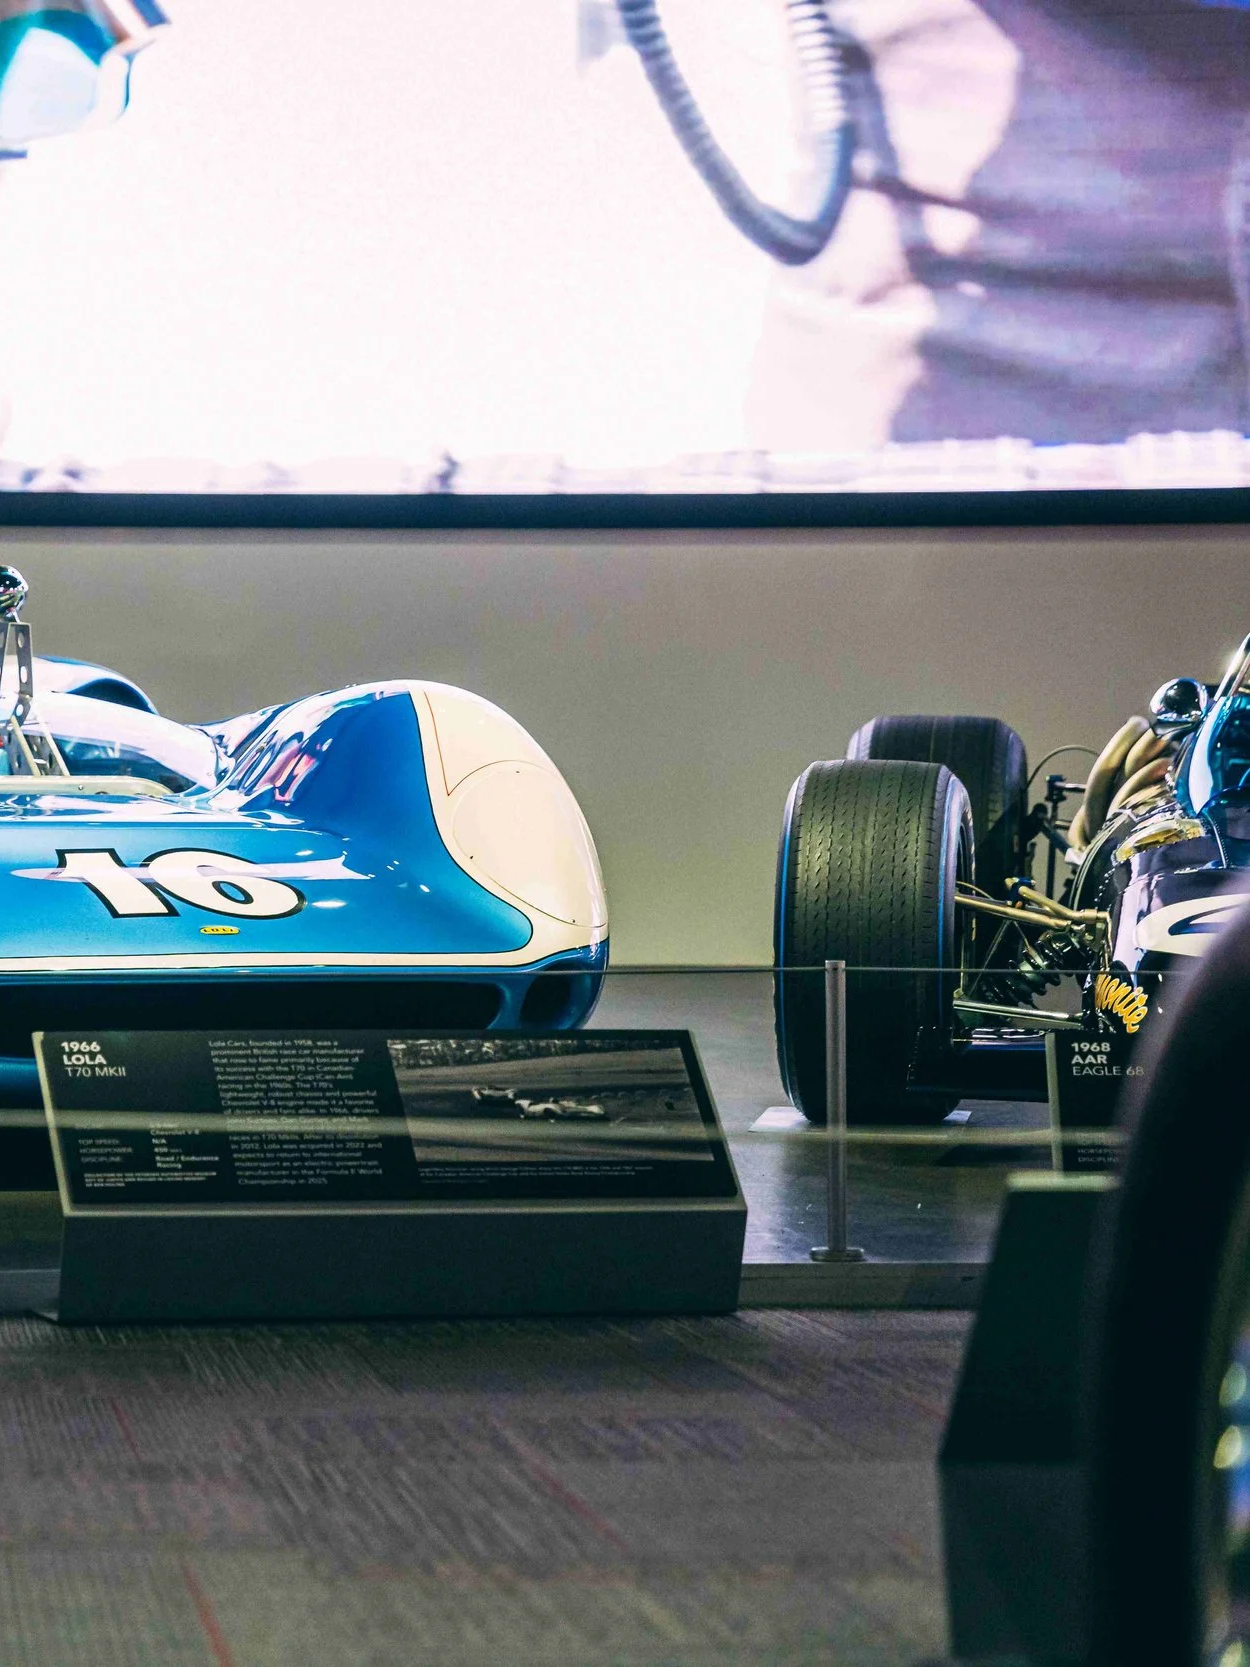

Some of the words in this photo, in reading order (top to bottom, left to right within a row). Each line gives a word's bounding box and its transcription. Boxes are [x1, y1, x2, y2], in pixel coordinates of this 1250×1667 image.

[55, 847, 307, 920] 16
[61, 1041, 101, 1053] 1966
[1070, 1042, 1111, 1052] 1968
[63, 1054, 107, 1065] LOLA
[1071, 1054, 1108, 1064] AAR
[65, 1067, 91, 1077] T70
[95, 1066, 126, 1077] MKII
[1072, 1066, 1122, 1076] EAGLE
[1126, 1066, 1145, 1076] 68
